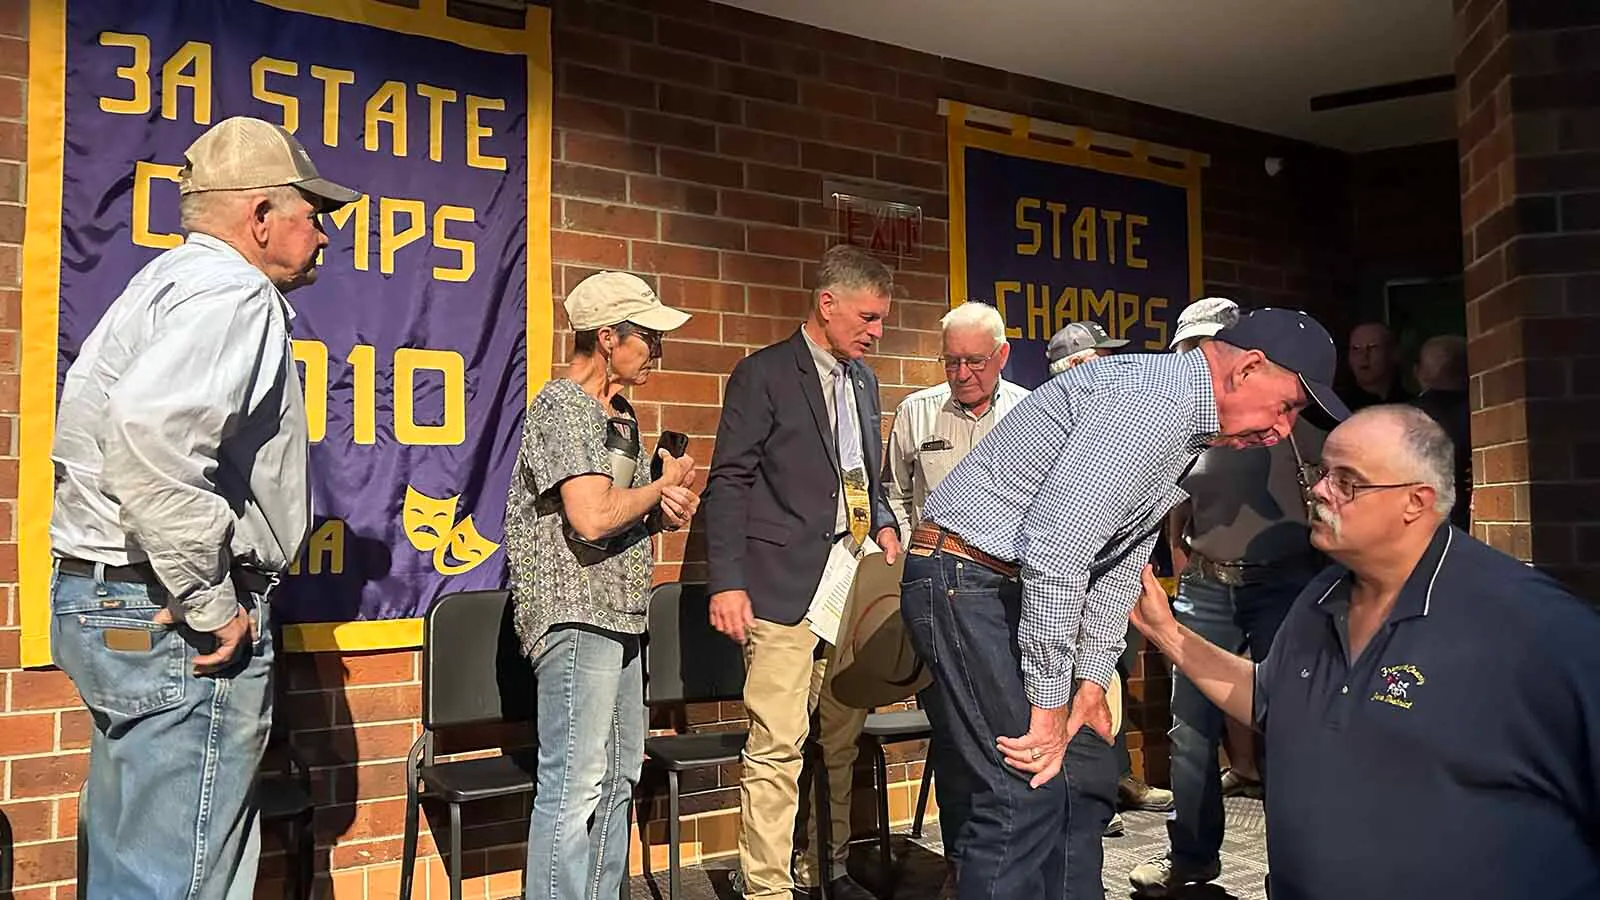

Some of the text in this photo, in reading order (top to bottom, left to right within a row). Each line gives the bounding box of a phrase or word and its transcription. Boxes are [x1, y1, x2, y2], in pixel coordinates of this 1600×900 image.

[99, 31, 508, 171] 3A STATE
[132, 160, 478, 283] CMPS
[846, 205, 919, 255] EXIT
[1016, 196, 1149, 270] STATE
[994, 280, 1169, 350] CHAMPS
